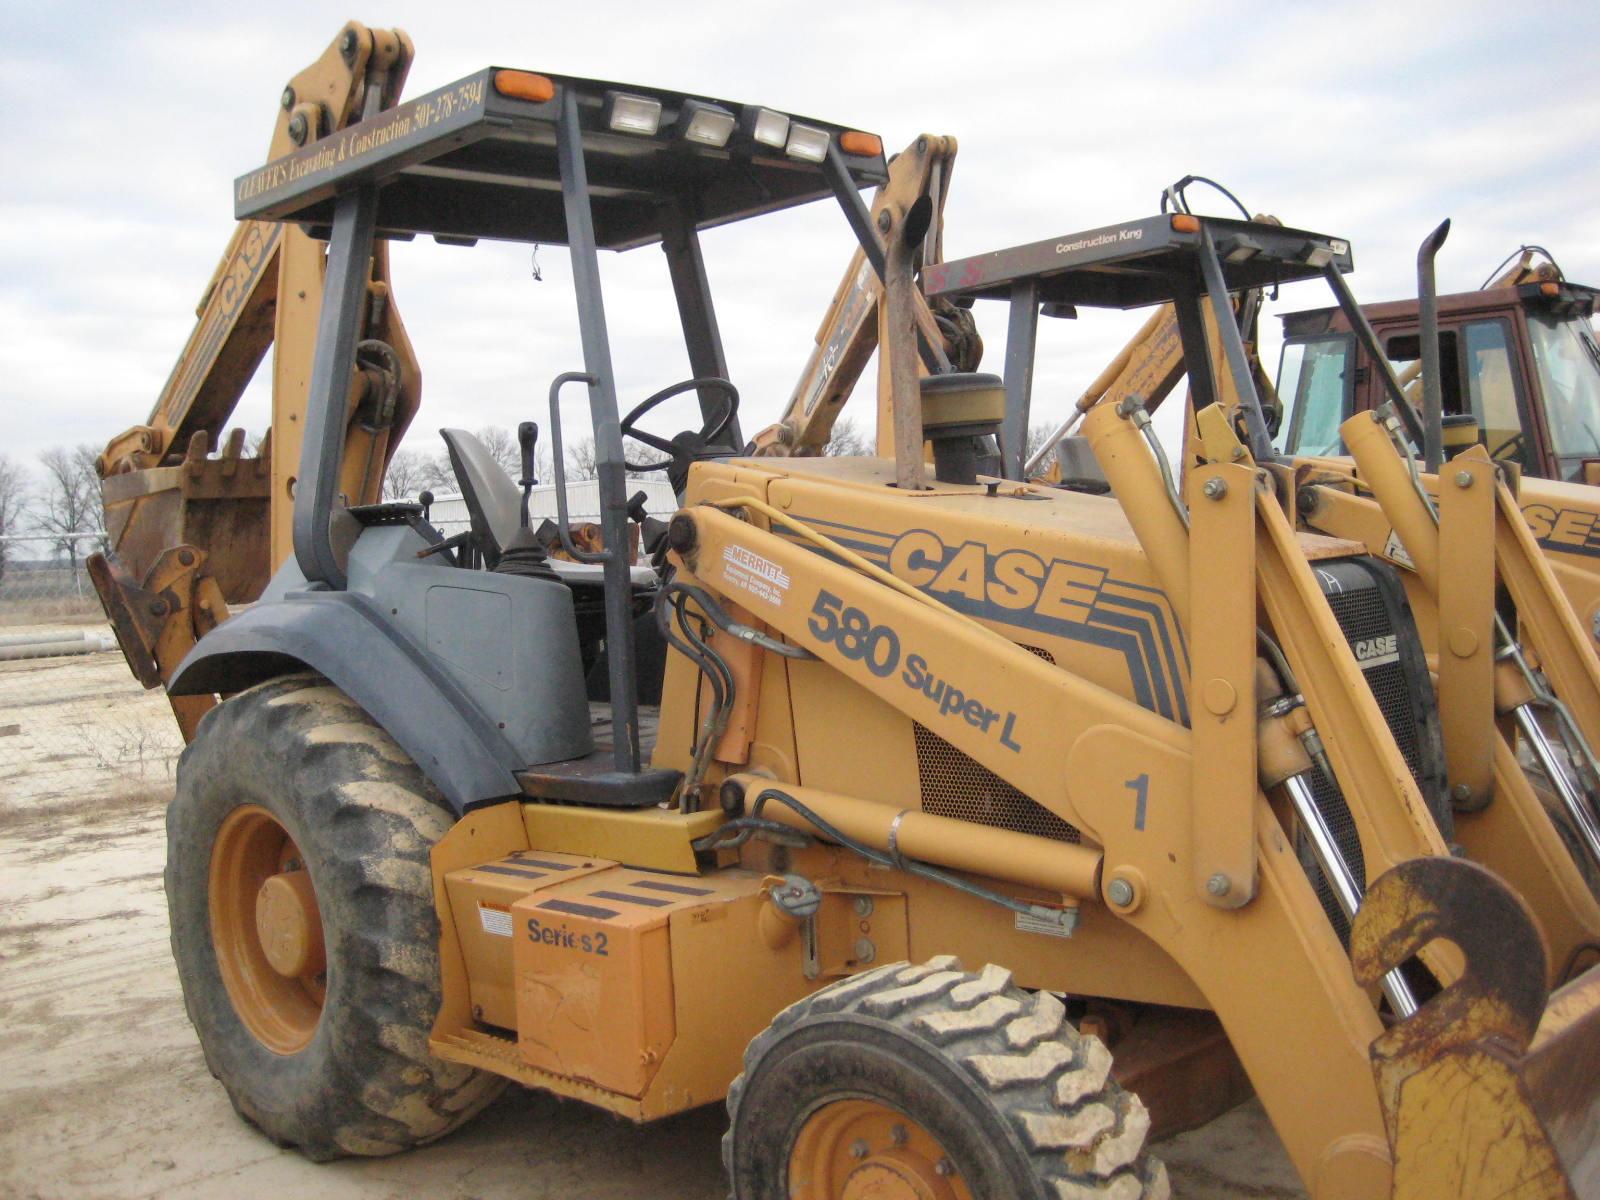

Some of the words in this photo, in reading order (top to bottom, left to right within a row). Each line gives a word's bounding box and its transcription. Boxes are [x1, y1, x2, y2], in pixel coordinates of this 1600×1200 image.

[290, 147, 336, 179] Excavating
[338, 138, 346, 161] &
[349, 116, 411, 157] Construction
[413, 80, 482, 131] 501-278-7594
[1056, 234, 1117, 254] Construction
[1119, 228, 1143, 241] King
[888, 528, 1109, 624] CASE
[807, 588, 901, 678] 580
[902, 653, 1001, 734] Super
[1000, 711, 1022, 754] L
[1355, 635, 1397, 661] CASE
[1124, 773, 1149, 832] 1
